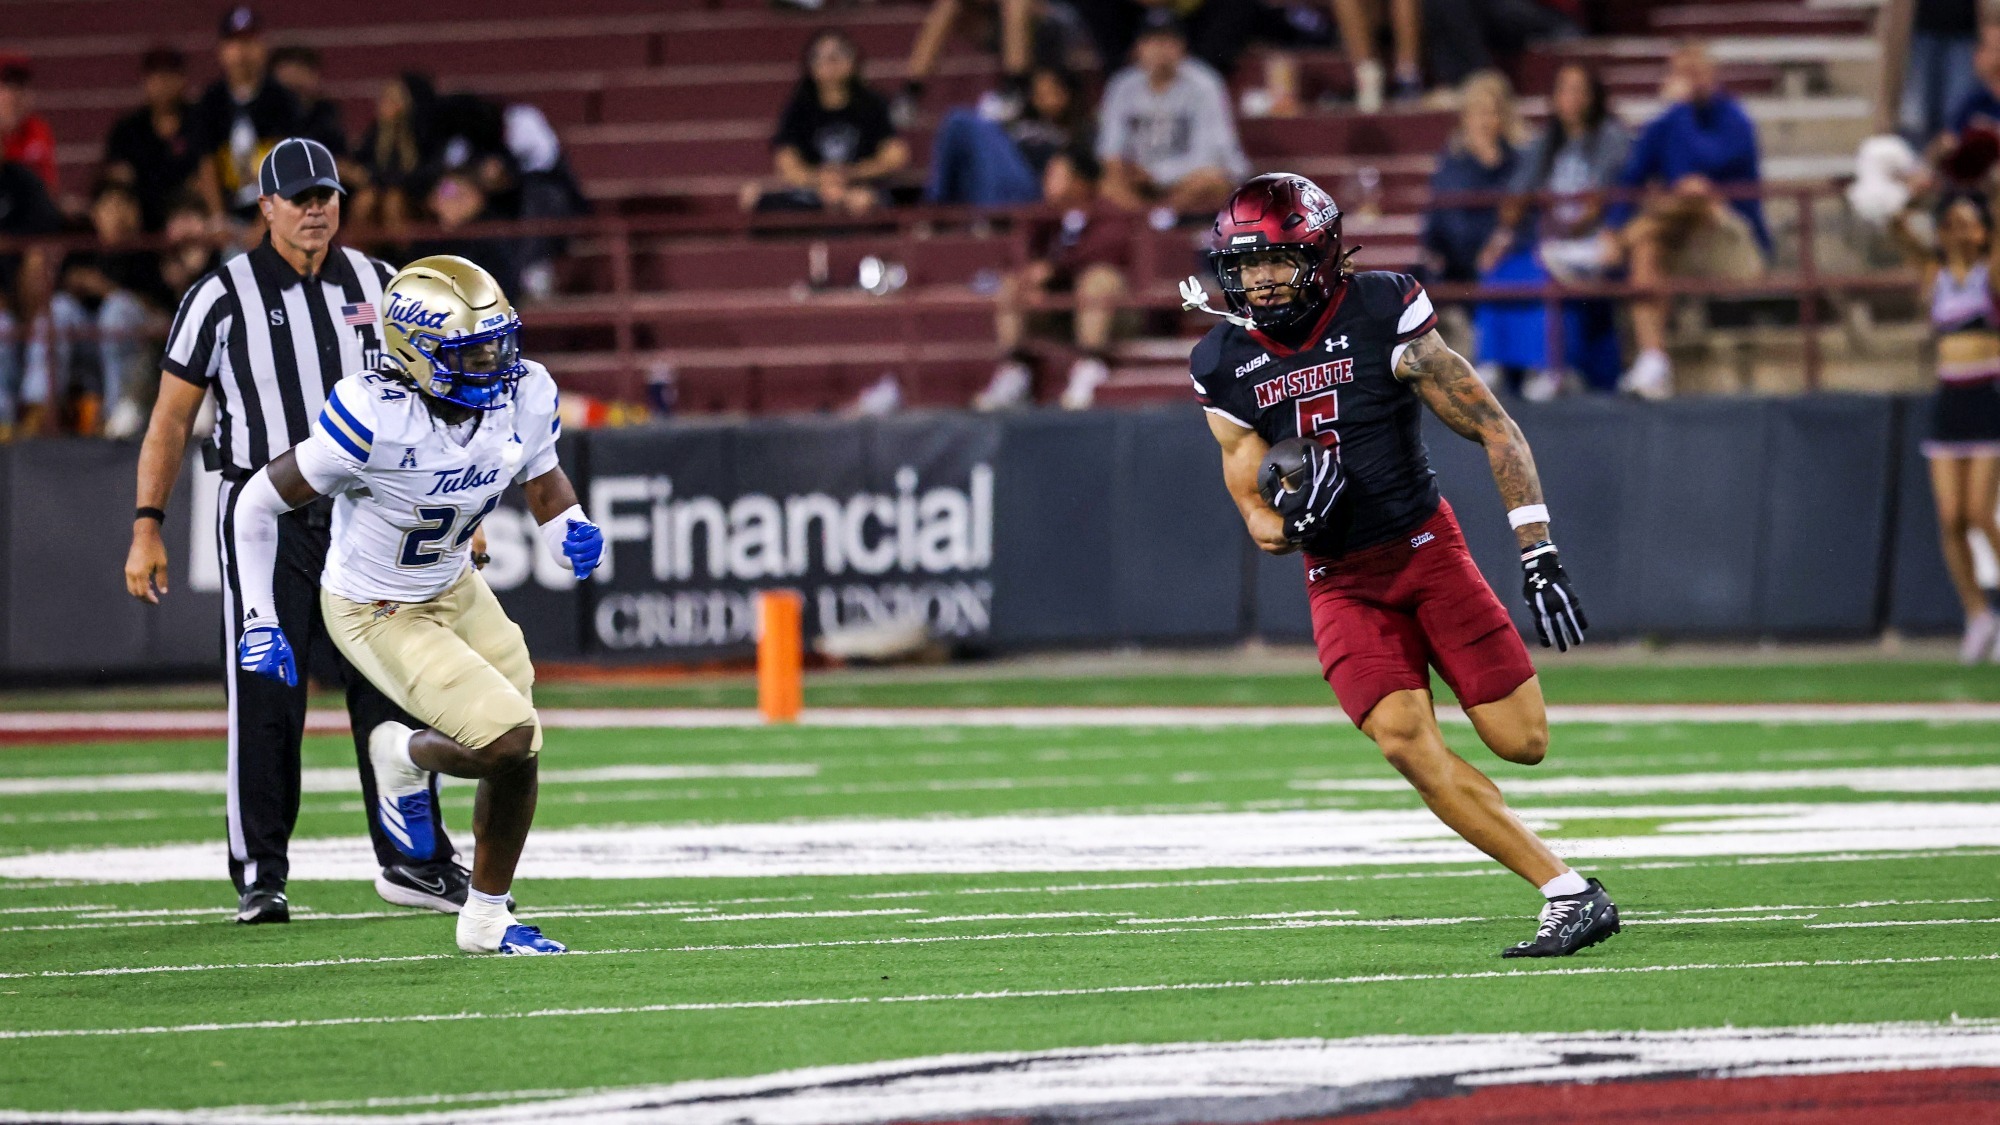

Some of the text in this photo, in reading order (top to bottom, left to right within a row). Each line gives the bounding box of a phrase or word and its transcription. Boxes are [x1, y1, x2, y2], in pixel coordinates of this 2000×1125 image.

[269, 308, 285, 326] S
[385, 292, 451, 329] Tulsa
[1254, 357, 1354, 409] NM STATE
[1295, 389, 1341, 464] 5
[425, 464, 501, 496] Tulsa
[590, 463, 994, 584] Financial
[1411, 532, 1435, 548] State
[595, 589, 768, 648] CREDI
